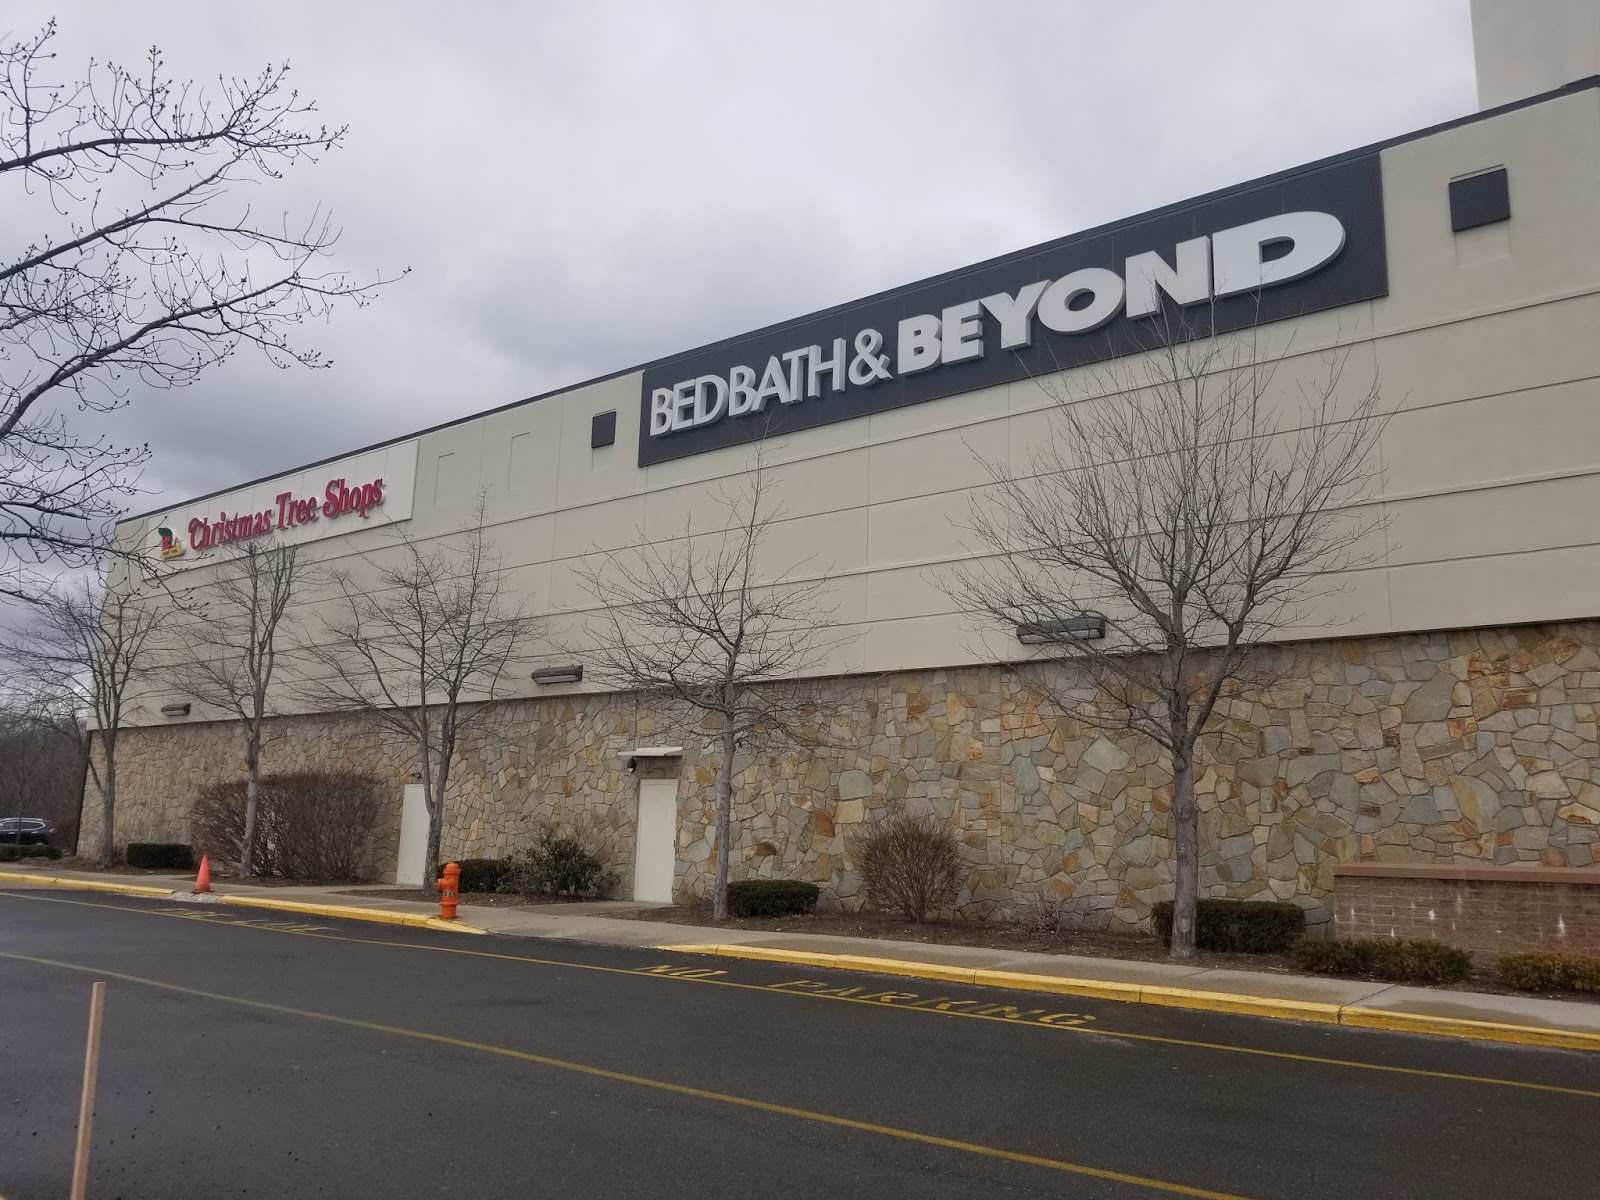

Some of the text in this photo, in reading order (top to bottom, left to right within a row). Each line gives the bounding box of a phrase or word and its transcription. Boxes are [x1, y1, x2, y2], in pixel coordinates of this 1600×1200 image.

[848, 327, 895, 388] &
[897, 210, 1346, 376] BEYOND
[187, 476, 386, 551] Christmas Tree Shops
[634, 964, 1098, 1027] NO PARKING
